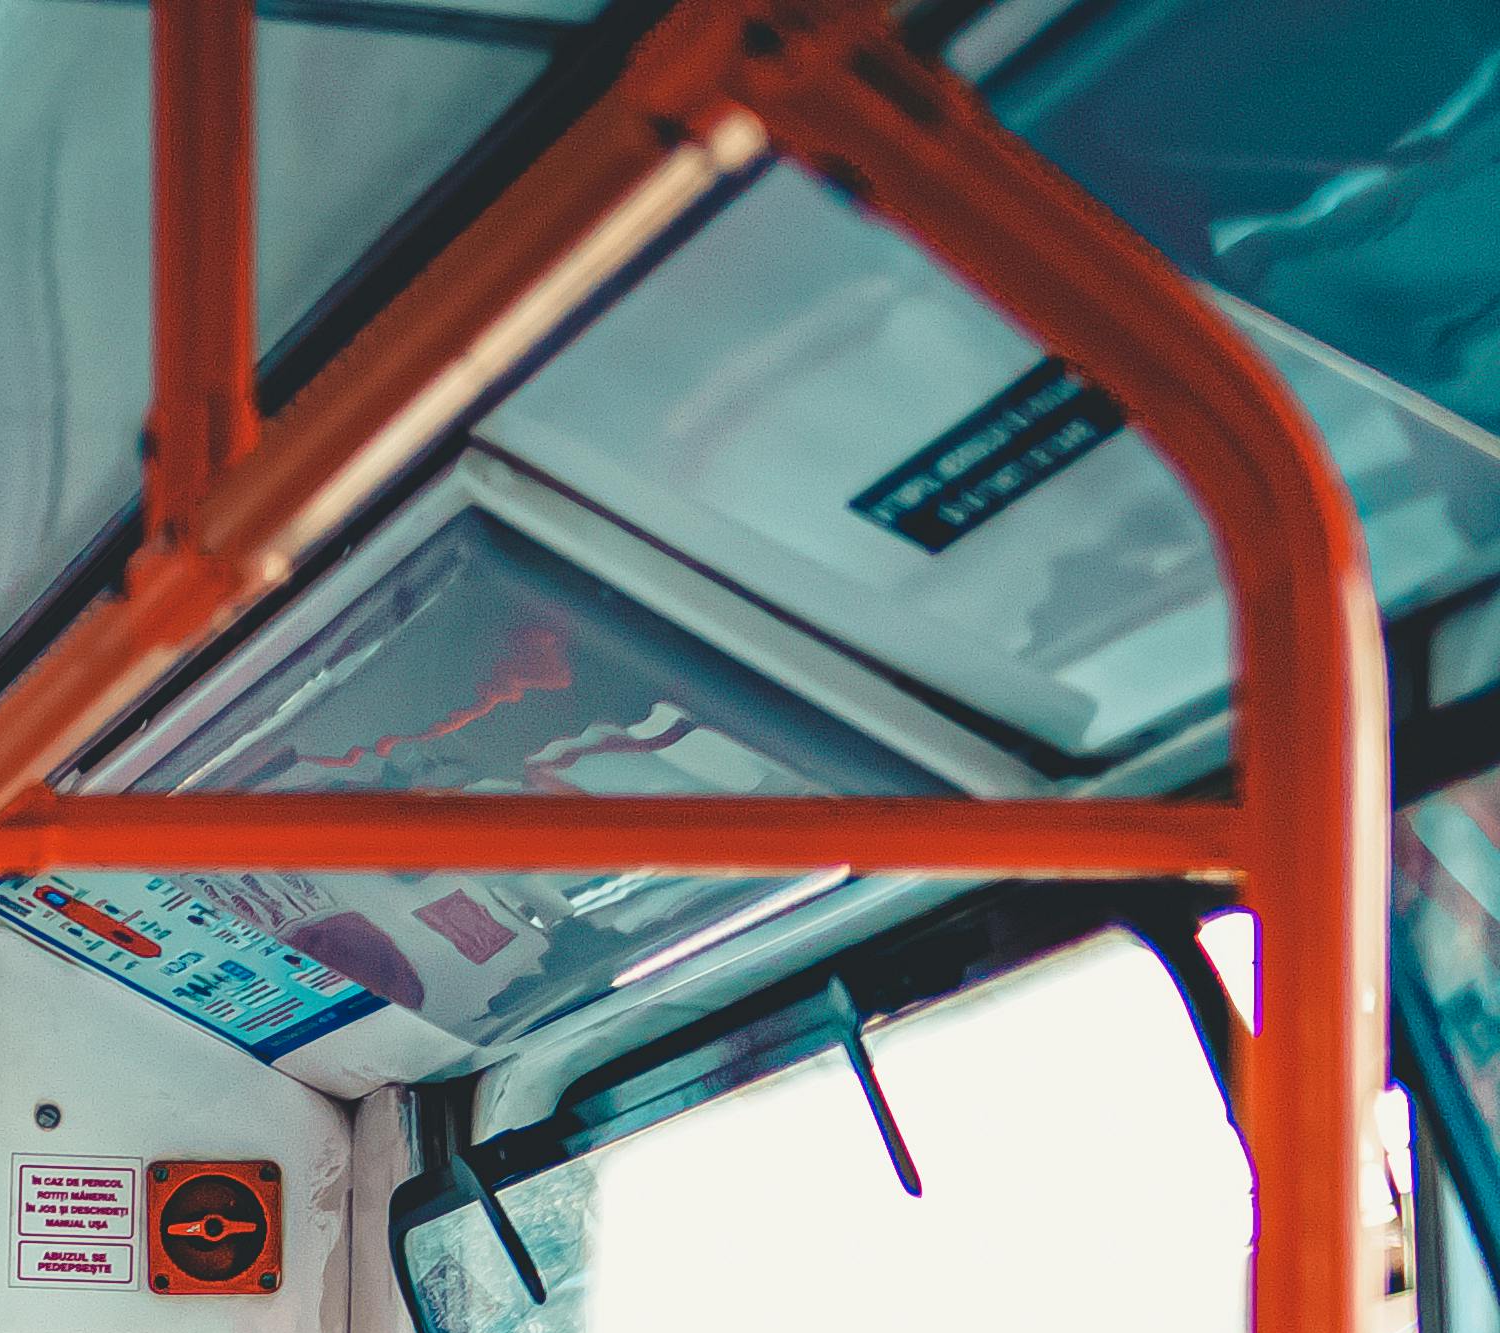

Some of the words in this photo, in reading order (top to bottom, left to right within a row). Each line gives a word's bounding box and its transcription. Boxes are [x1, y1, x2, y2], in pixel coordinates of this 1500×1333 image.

[44, 1177, 64, 1186] CAZ
[66, 1178, 79, 1186] DE
[82, 1179, 123, 1188] PERICOL
[38, 1205, 57, 1213] JOS
[45, 1219, 86, 1228] MANUAL
[43, 1252, 88, 1262] ABUZUL
[91, 1253, 107, 1262] SE
